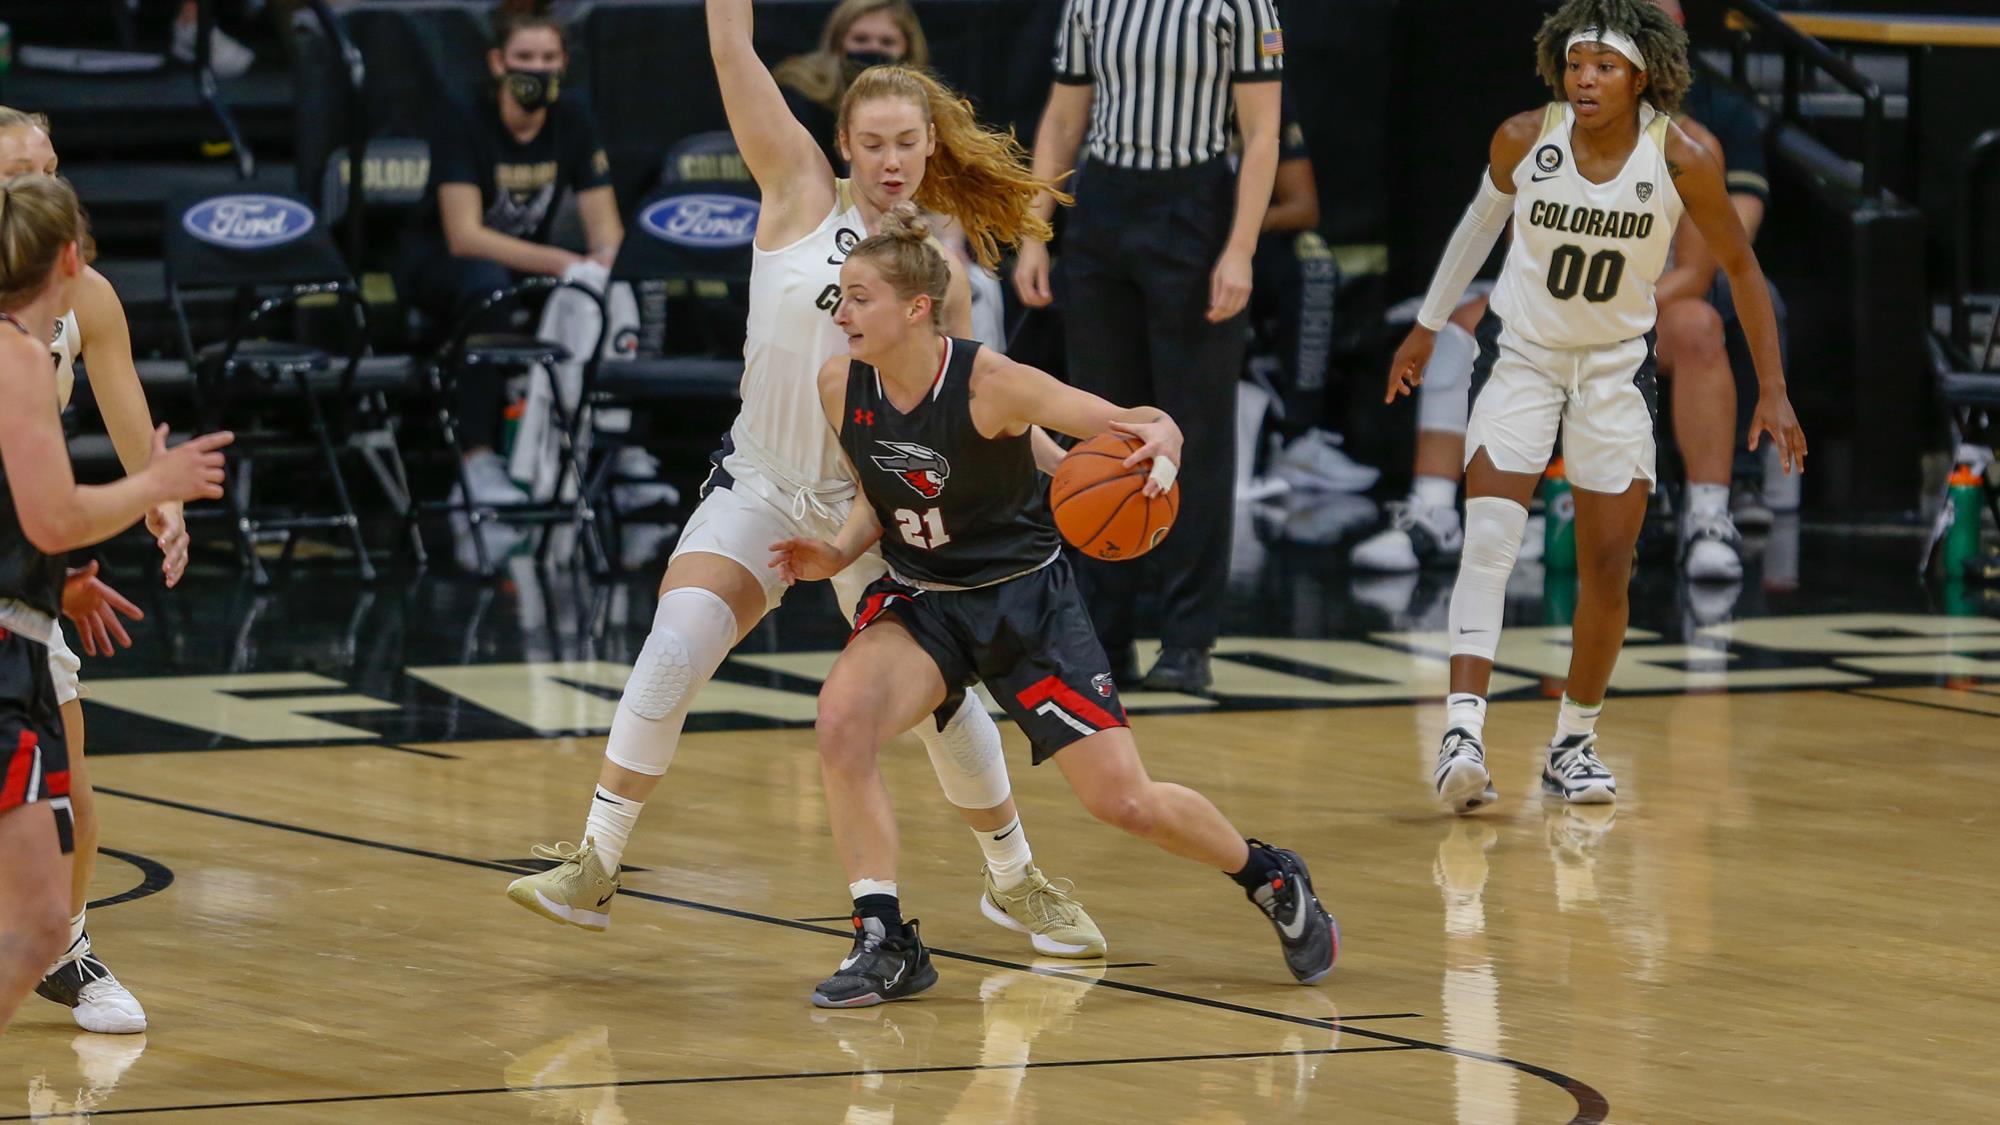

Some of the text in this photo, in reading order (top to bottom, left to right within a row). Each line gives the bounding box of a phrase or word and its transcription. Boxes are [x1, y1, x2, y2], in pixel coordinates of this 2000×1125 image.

[210, 202, 288, 236] Ford
[667, 203, 754, 236] Ford
[1530, 200, 1655, 239] COLORADO
[1547, 244, 1626, 302] 00
[894, 507, 951, 550] 21
